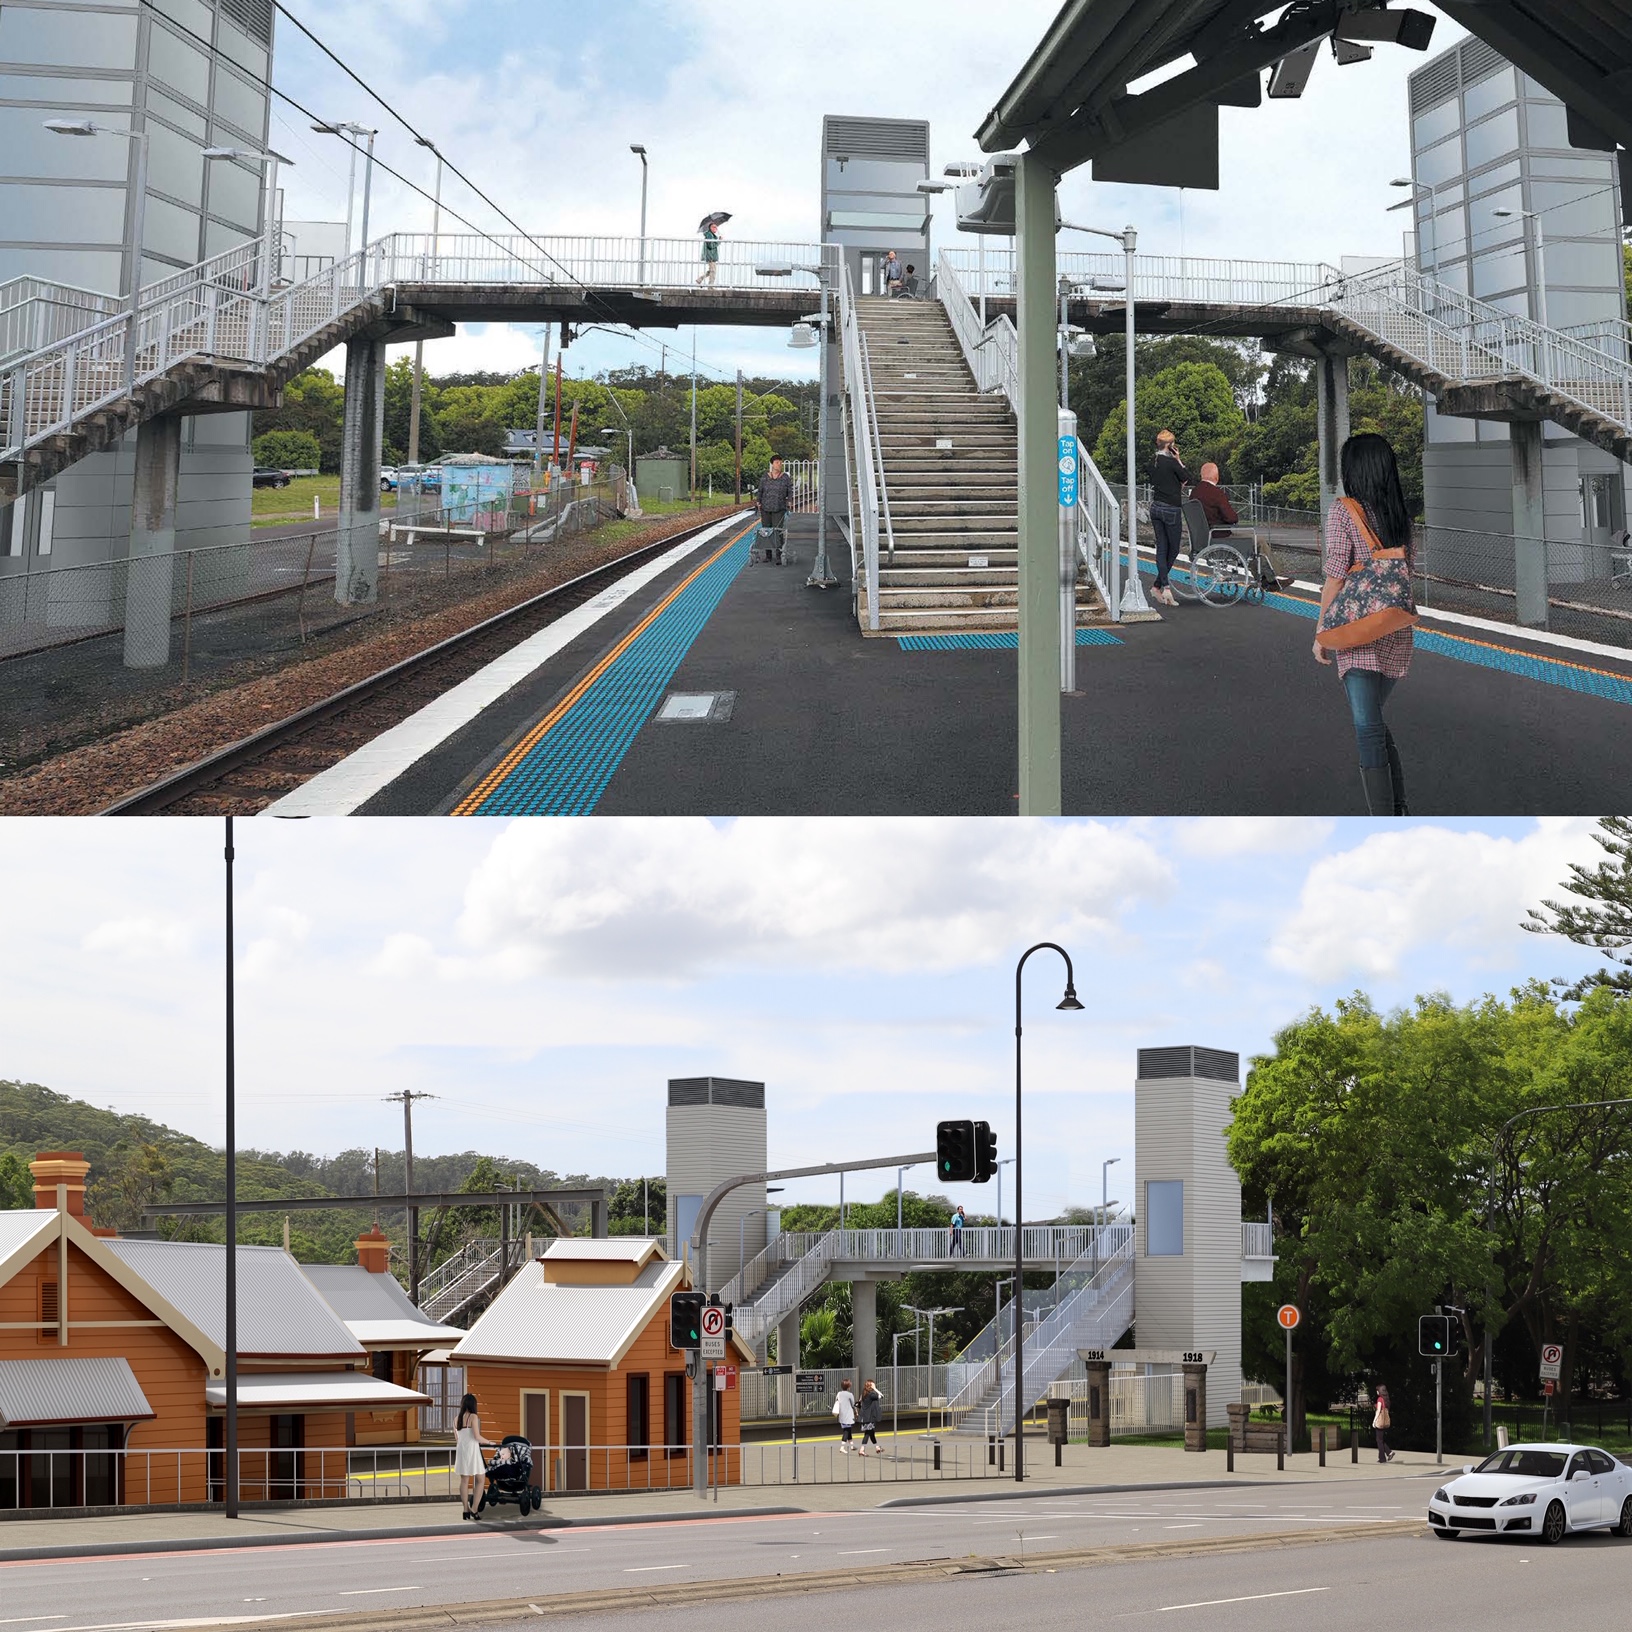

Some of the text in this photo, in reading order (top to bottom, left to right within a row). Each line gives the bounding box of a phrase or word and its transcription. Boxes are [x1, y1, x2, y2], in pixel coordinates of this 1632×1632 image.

[1060, 440, 1074, 448] Tap
[1061, 477, 1074, 485] Tap
[1283, 1311, 1293, 1324] T
[1087, 1350, 1104, 1360] 1914
[1182, 1352, 1203, 1363] 1918
